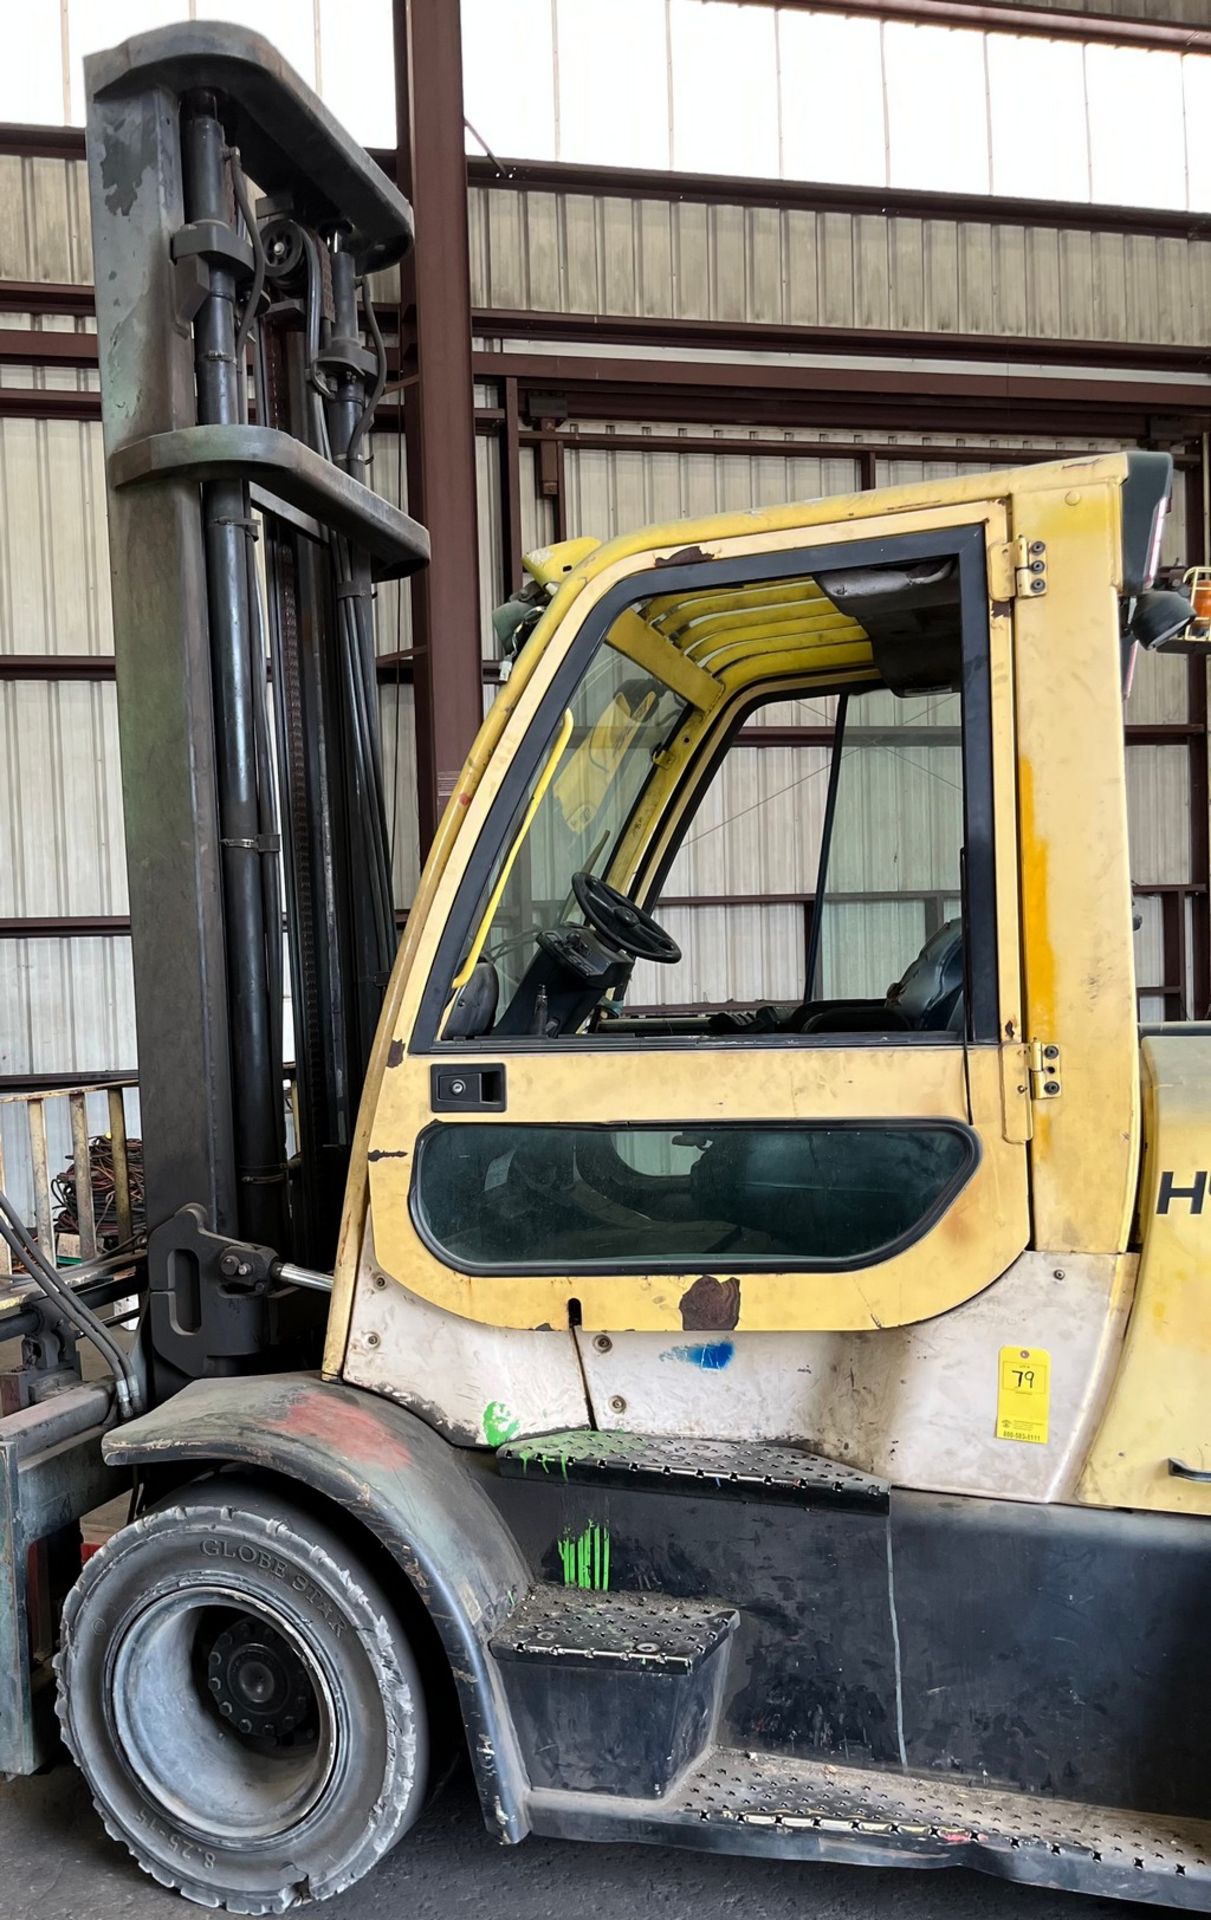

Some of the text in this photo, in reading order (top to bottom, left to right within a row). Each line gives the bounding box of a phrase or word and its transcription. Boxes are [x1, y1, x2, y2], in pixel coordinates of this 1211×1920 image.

[1156, 1171, 1211, 1214] H
[1012, 1370, 1035, 1389] 79
[201, 1539, 348, 1638] GLOBE STAR
[135, 1809, 217, 1870] 8.25-15
